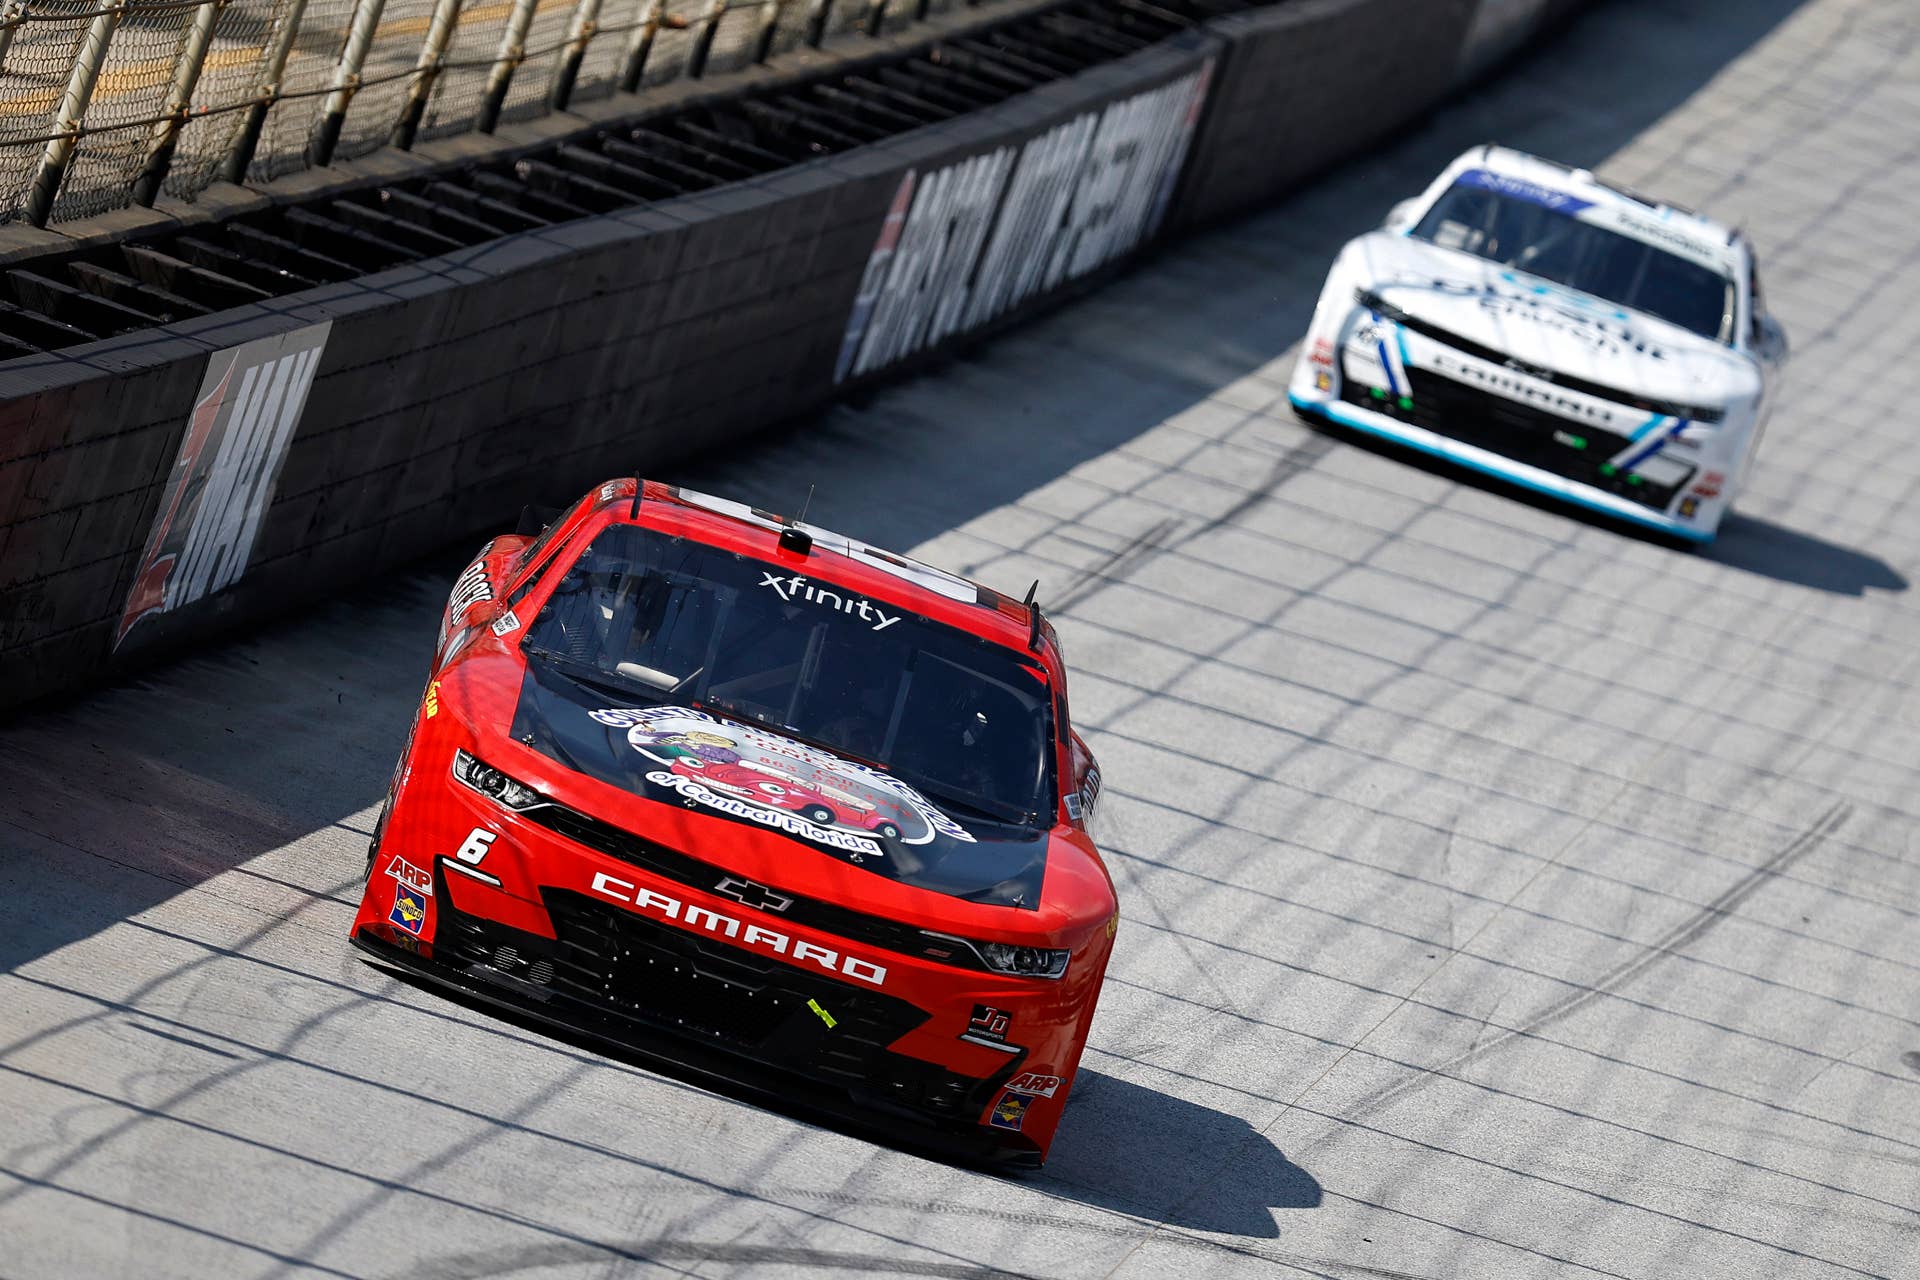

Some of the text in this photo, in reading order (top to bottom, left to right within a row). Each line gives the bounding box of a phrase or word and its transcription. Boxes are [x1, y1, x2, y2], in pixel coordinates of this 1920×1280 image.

[758, 571, 902, 631] xfinity
[652, 771, 878, 852] of Central Florida
[457, 827, 498, 865] 6
[388, 858, 432, 889] ARP
[397, 899, 423, 920] SUNOCO
[591, 872, 887, 985] CAMARO
